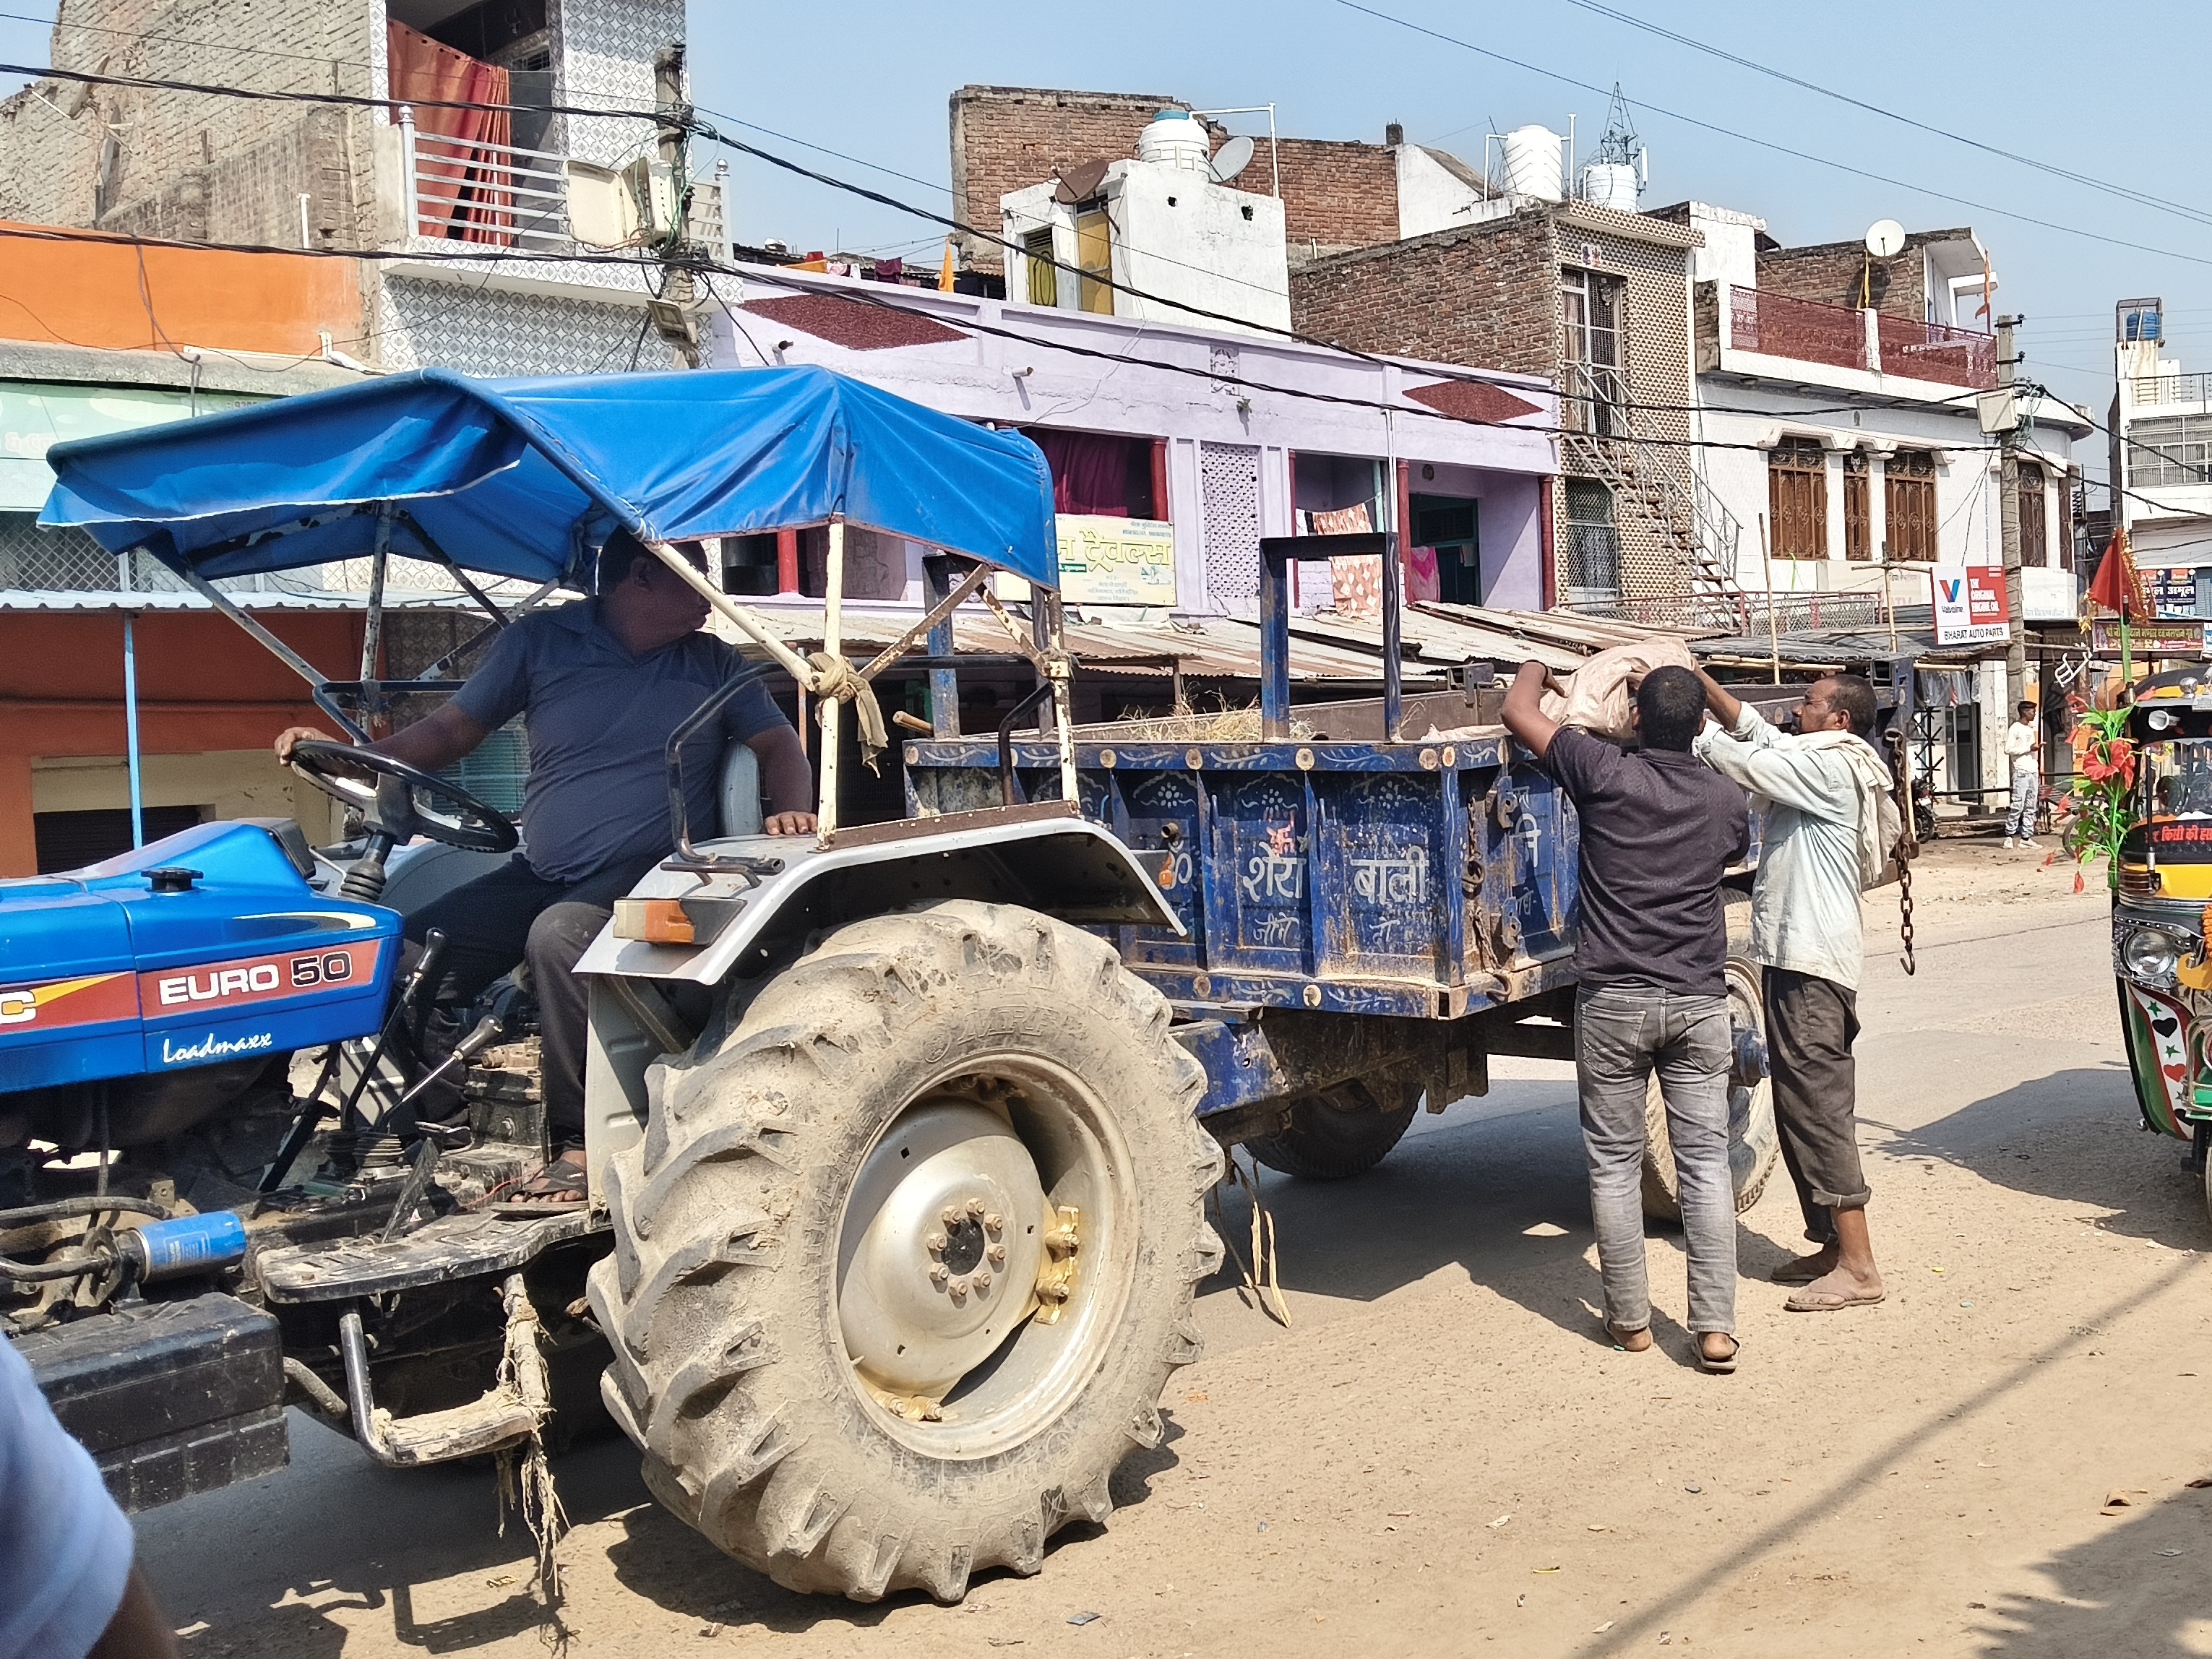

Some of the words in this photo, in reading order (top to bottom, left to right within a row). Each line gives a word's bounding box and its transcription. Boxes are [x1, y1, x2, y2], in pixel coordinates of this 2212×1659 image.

[1080, 527, 1171, 572] ट्रैवल्स
[1971, 590, 1996, 600] ORIGINAL
[1971, 602, 1990, 612] ENGINE
[1990, 601, 2000, 612] OIL
[2167, 586, 2195, 597] अमूल
[1944, 630, 1968, 640] BHARAT
[1969, 629, 1984, 639] AUTO
[1985, 627, 2004, 638] PARTS
[1242, 841, 1307, 903] शेरा
[158, 964, 280, 1005] EURO
[291, 950, 353, 988] 50
[957, 1004, 1060, 1046] MRF
[163, 1033, 272, 1064] Loadmaxx
